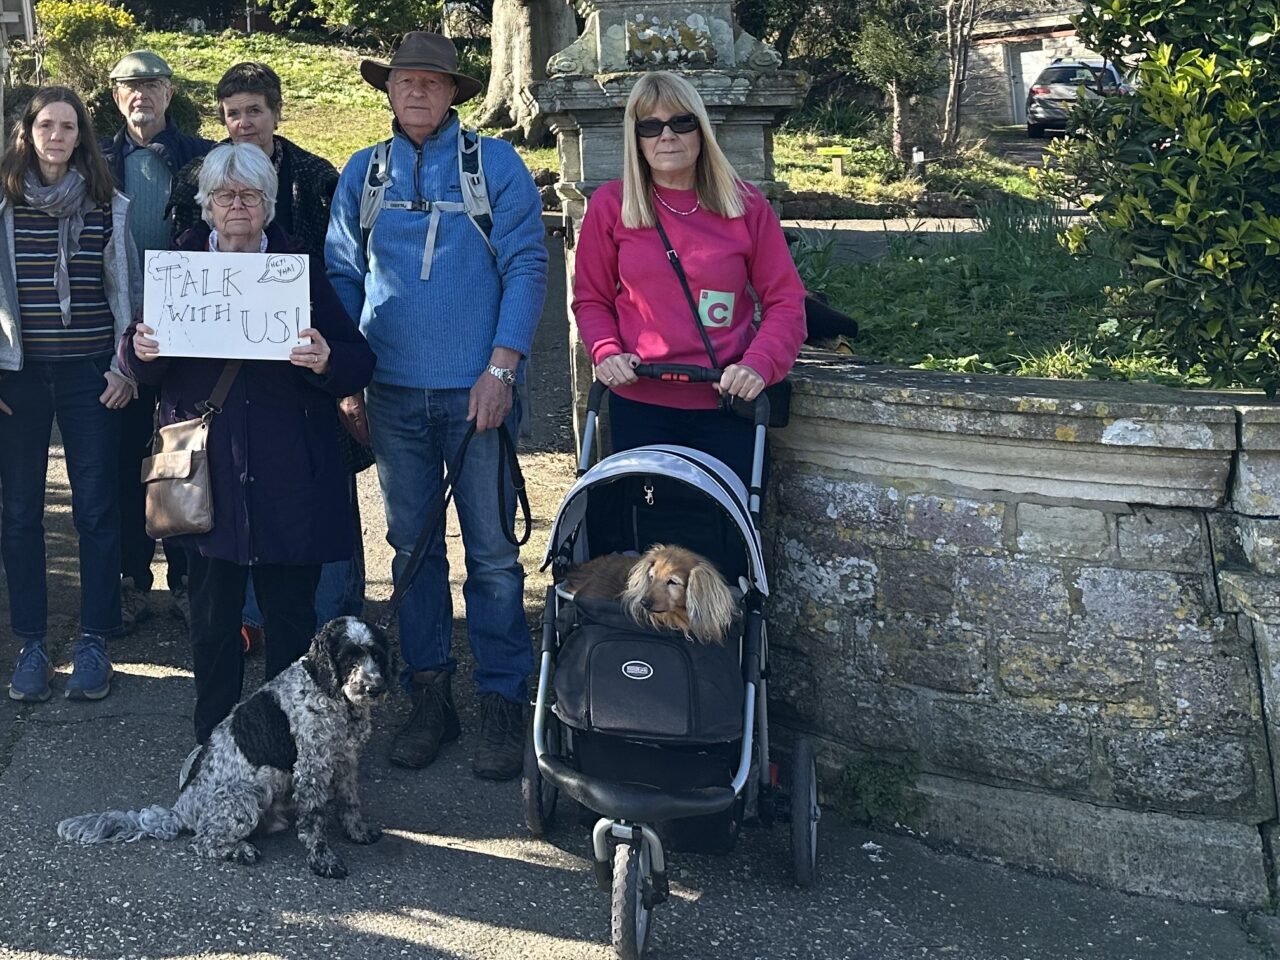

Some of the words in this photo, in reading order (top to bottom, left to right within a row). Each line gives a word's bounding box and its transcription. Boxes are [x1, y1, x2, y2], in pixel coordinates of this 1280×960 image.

[156, 264, 242, 297] TALK
[168, 303, 231, 323] WITH
[240, 307, 301, 344] US!
[707, 302, 729, 324] C
